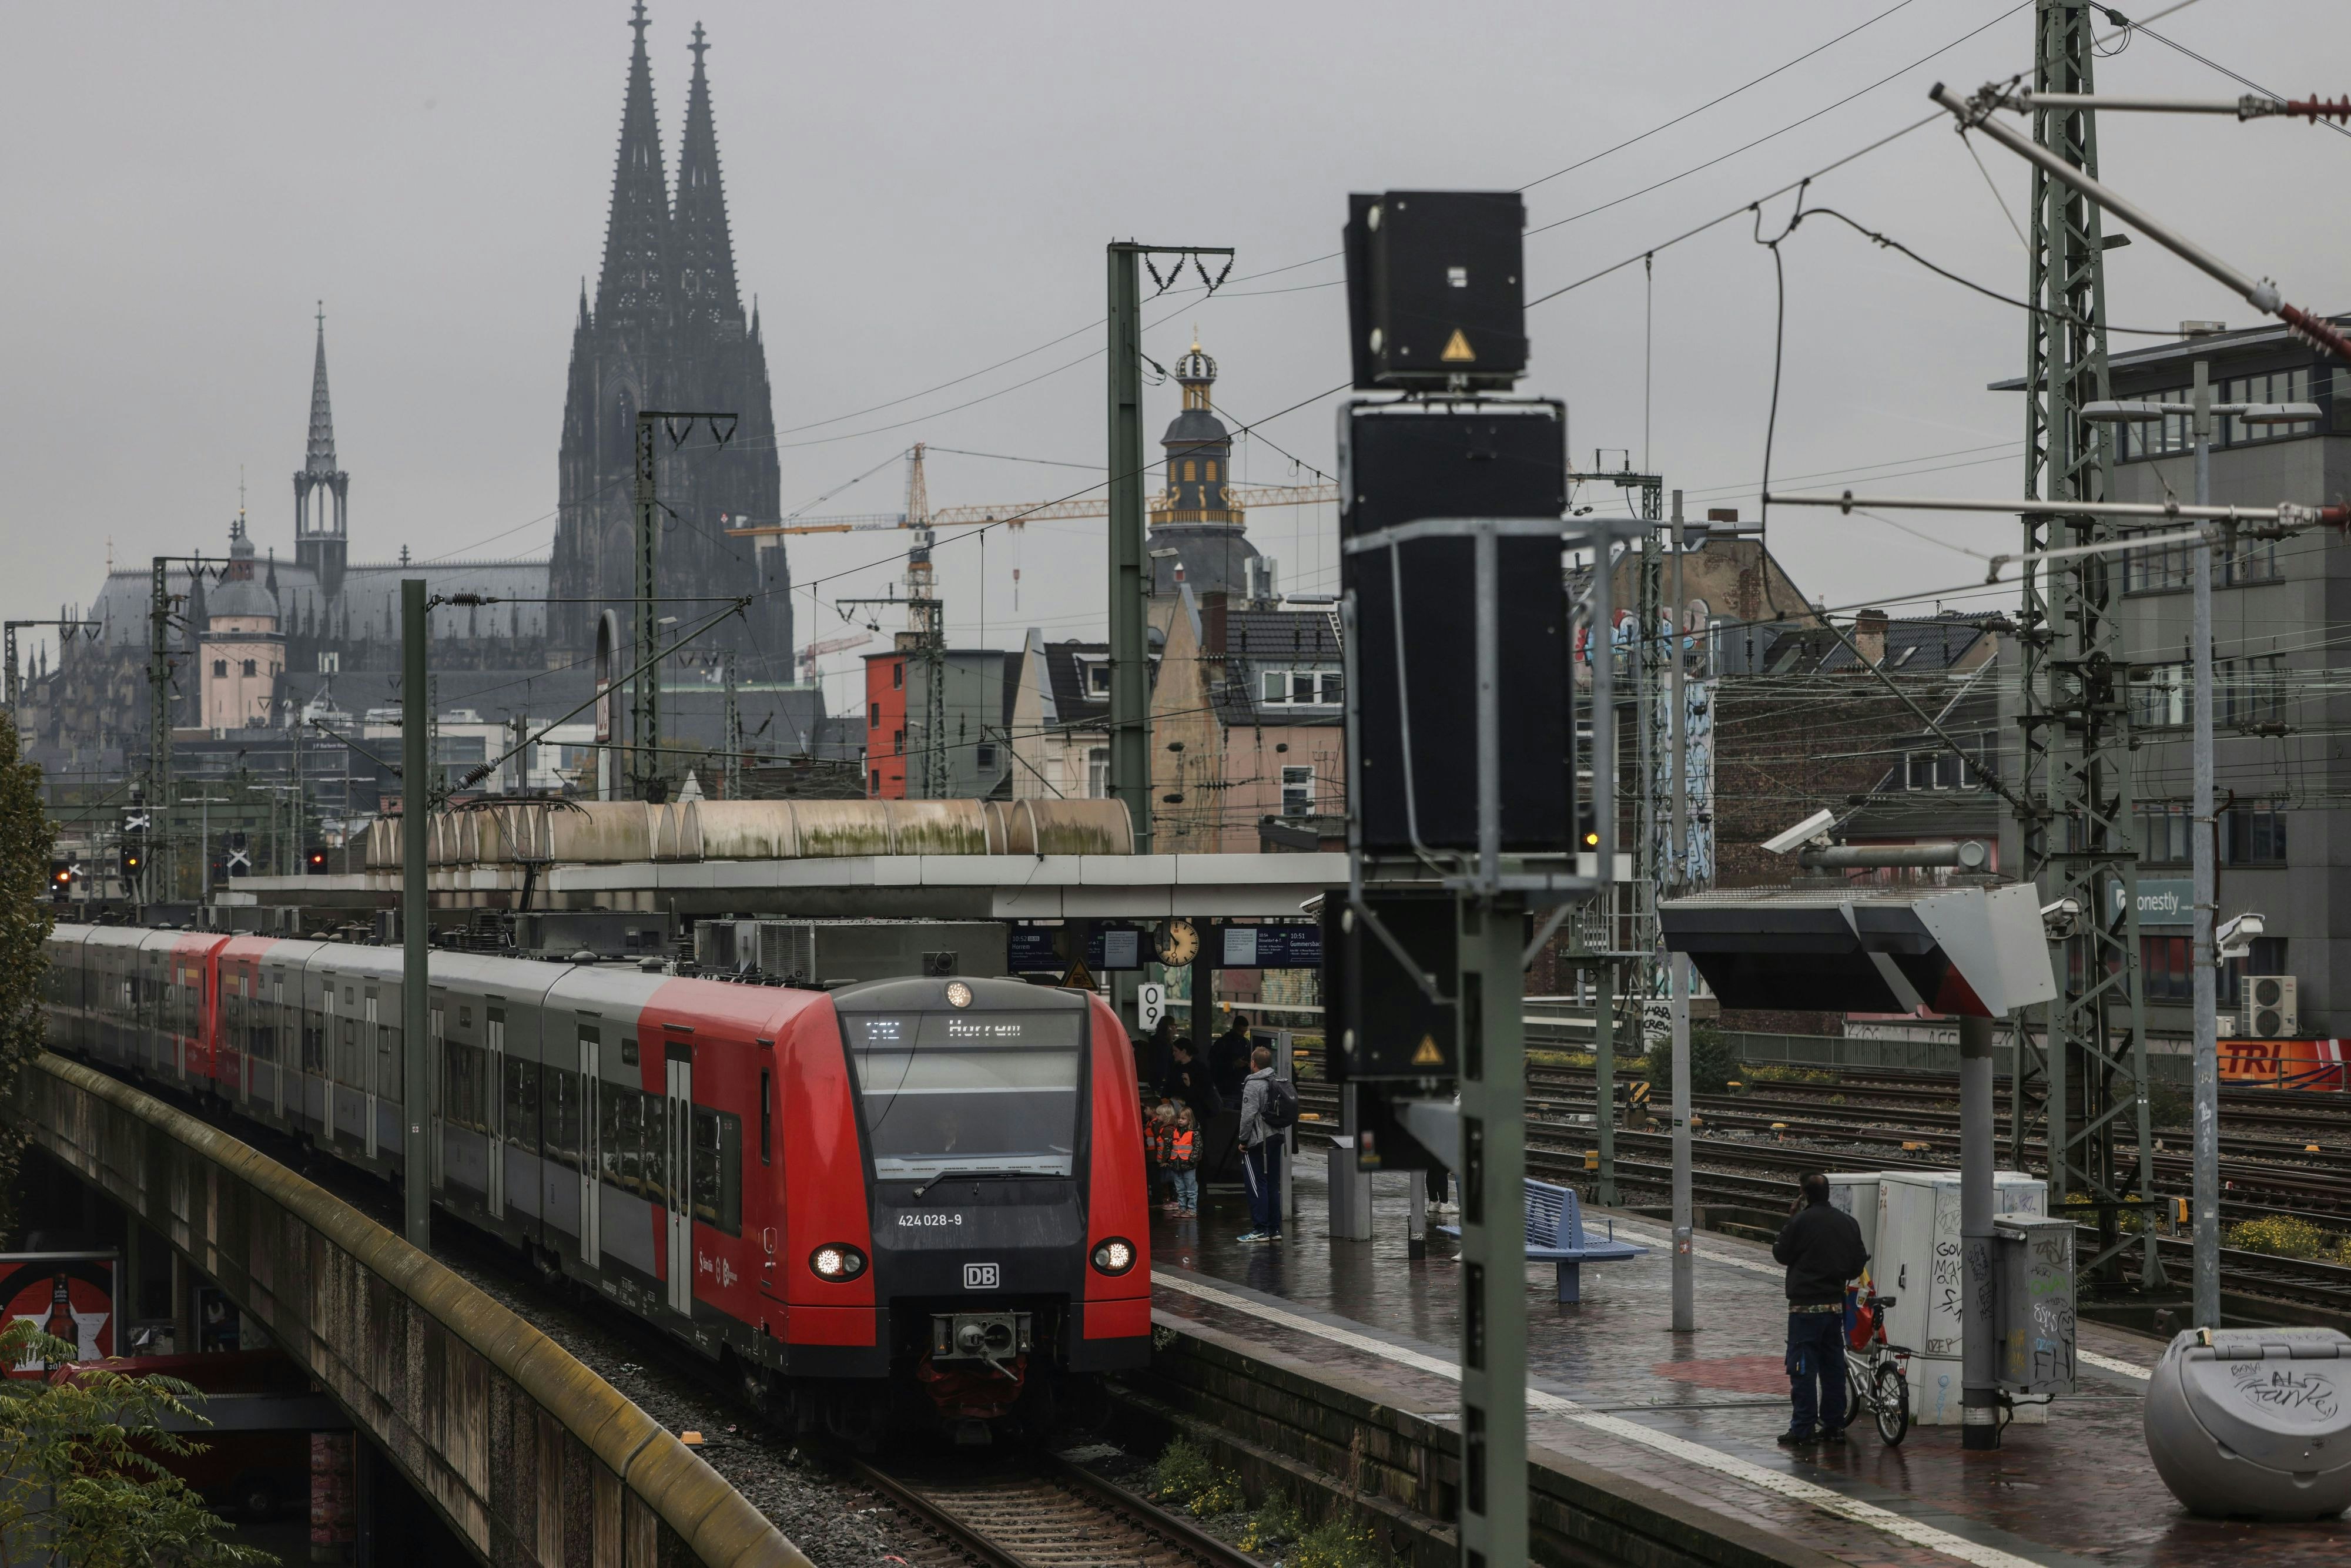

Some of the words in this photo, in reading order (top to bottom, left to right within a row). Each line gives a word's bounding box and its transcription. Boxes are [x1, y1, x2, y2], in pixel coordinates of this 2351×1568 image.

[2136, 891, 2179, 916] onestly
[949, 1020, 1021, 1037] Horrem
[2225, 1044, 2282, 1073] TRI
[715, 1115, 721, 1150] 2
[899, 1215, 922, 1227] 424
[923, 1214, 962, 1226] 028-9
[968, 1267, 995, 1285] DB
